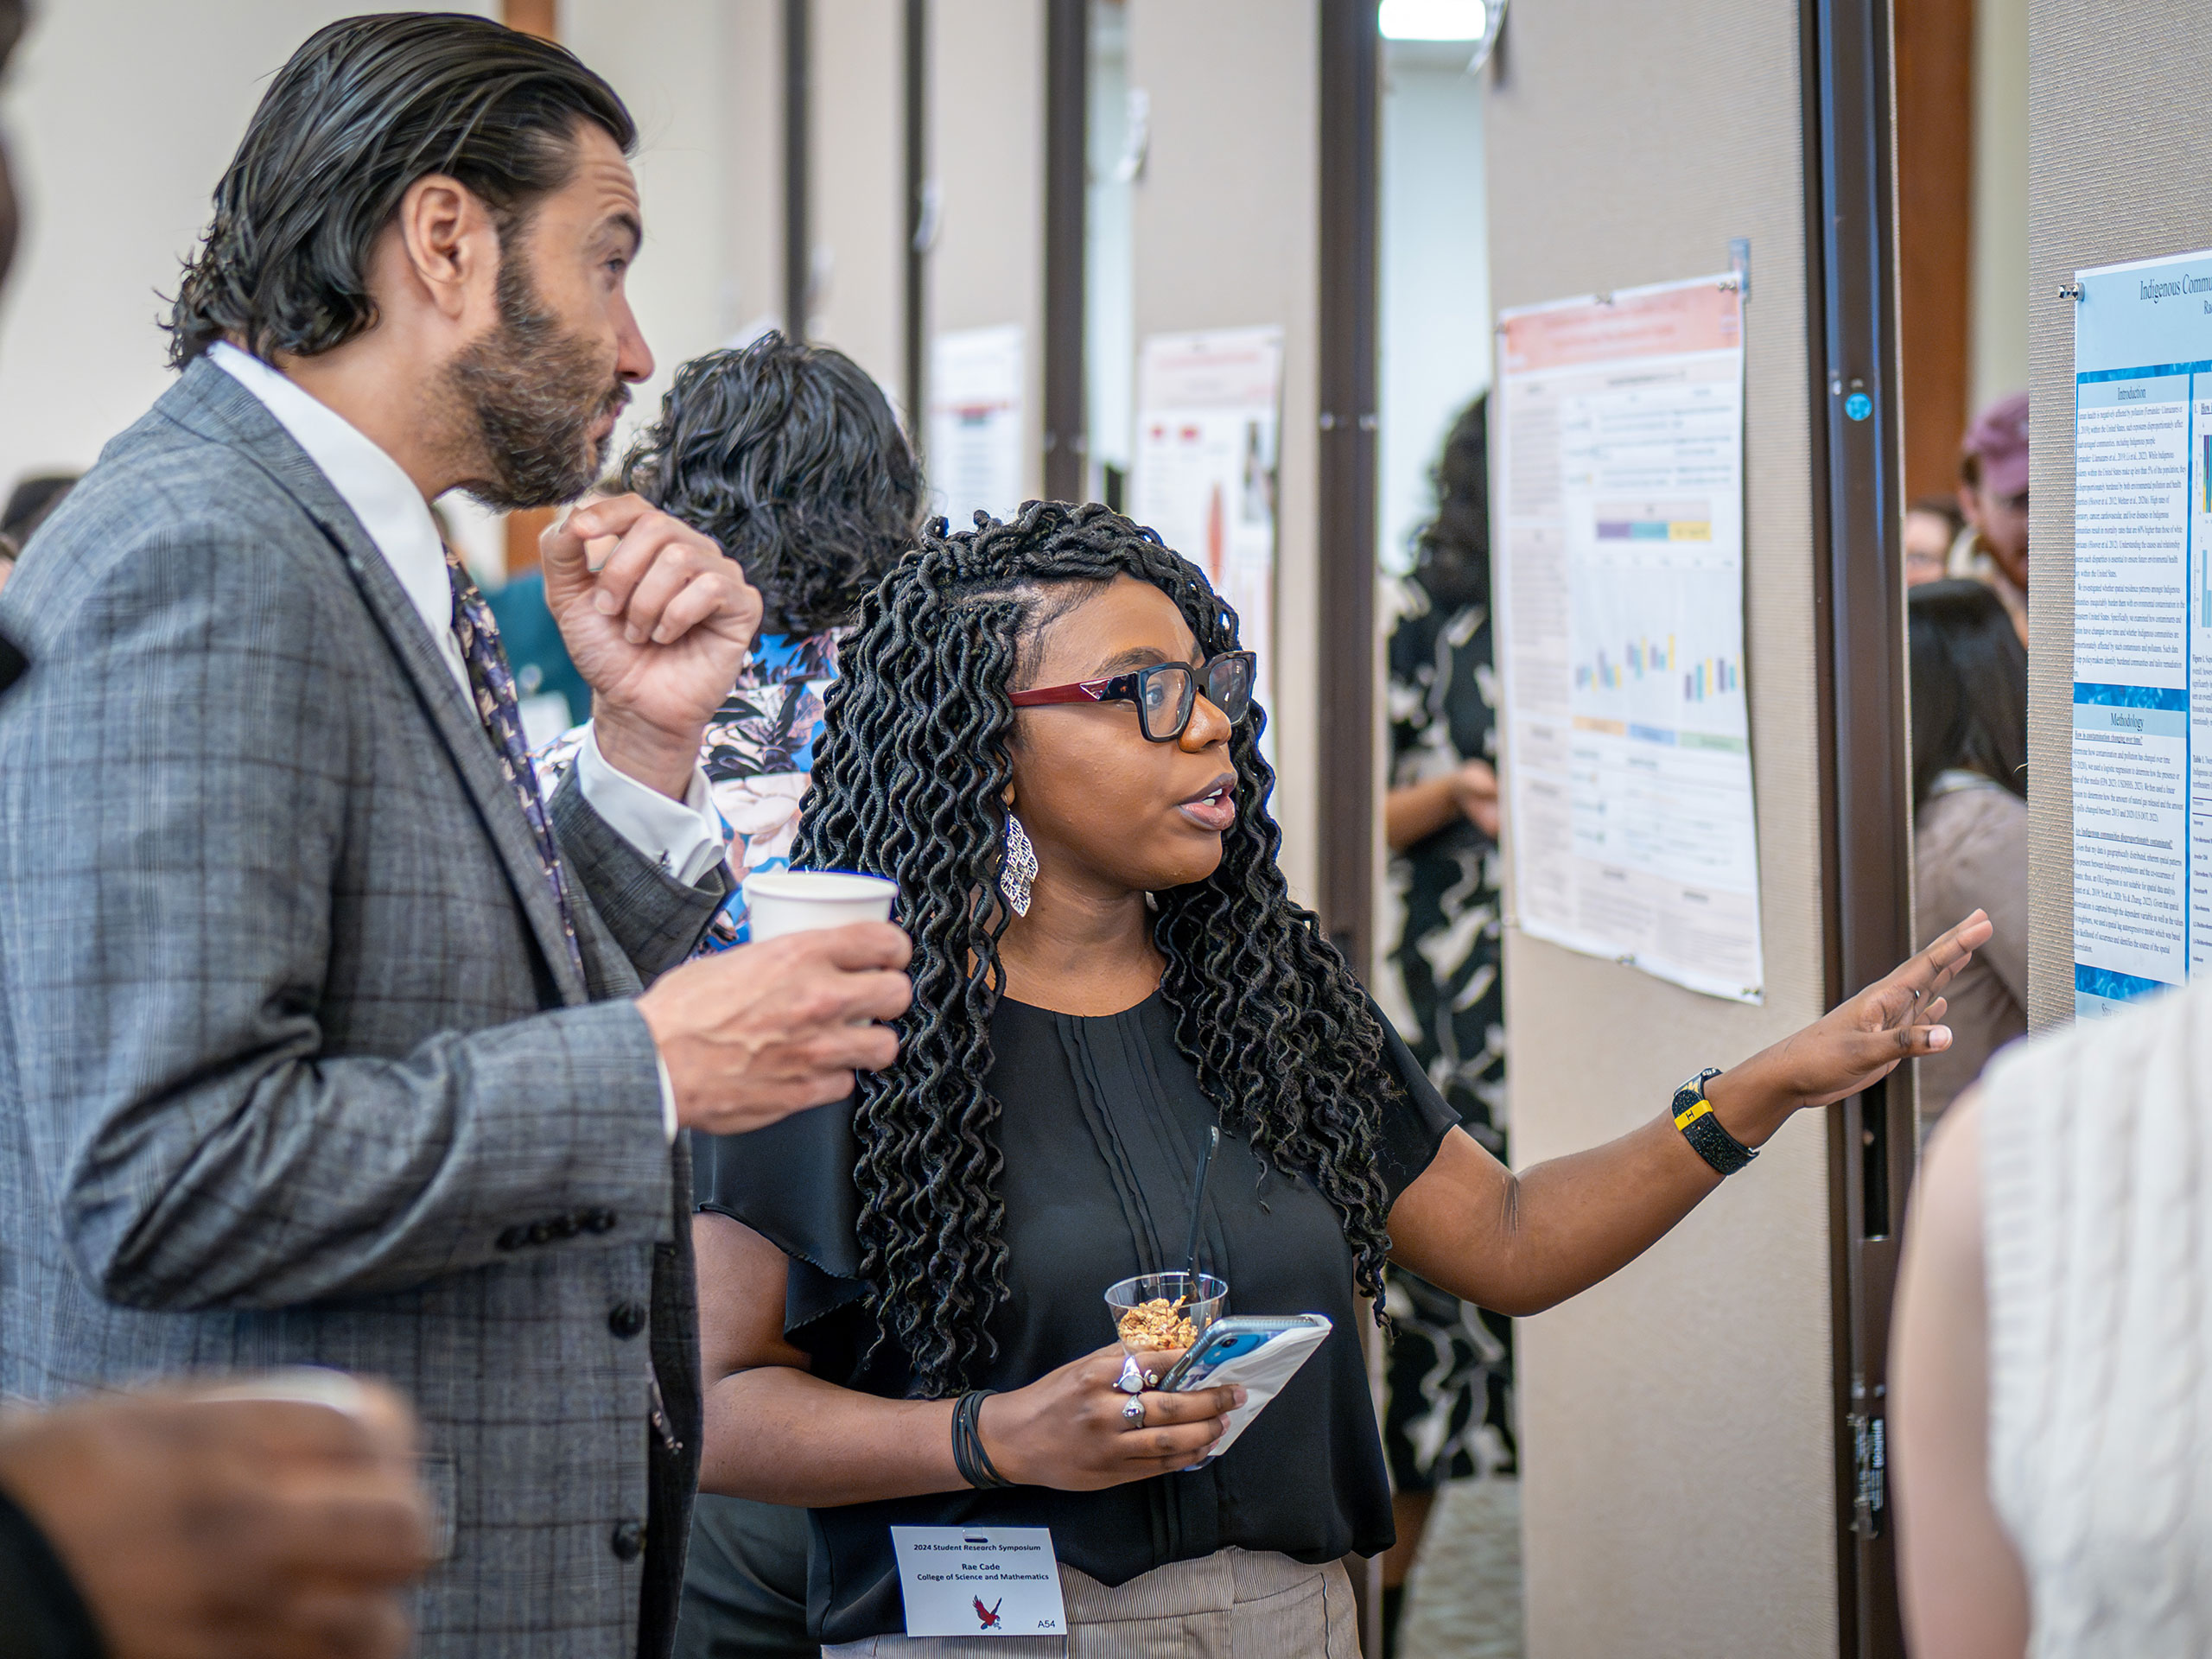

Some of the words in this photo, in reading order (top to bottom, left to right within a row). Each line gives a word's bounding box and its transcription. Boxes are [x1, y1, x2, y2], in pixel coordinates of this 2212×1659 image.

[2140, 278, 2181, 304] Indigenous
[2118, 385, 2146, 400] Introduction
[2111, 712, 2144, 732] Methodology
[917, 1573, 944, 1582] College
[1037, 1619, 1056, 1629] A54
